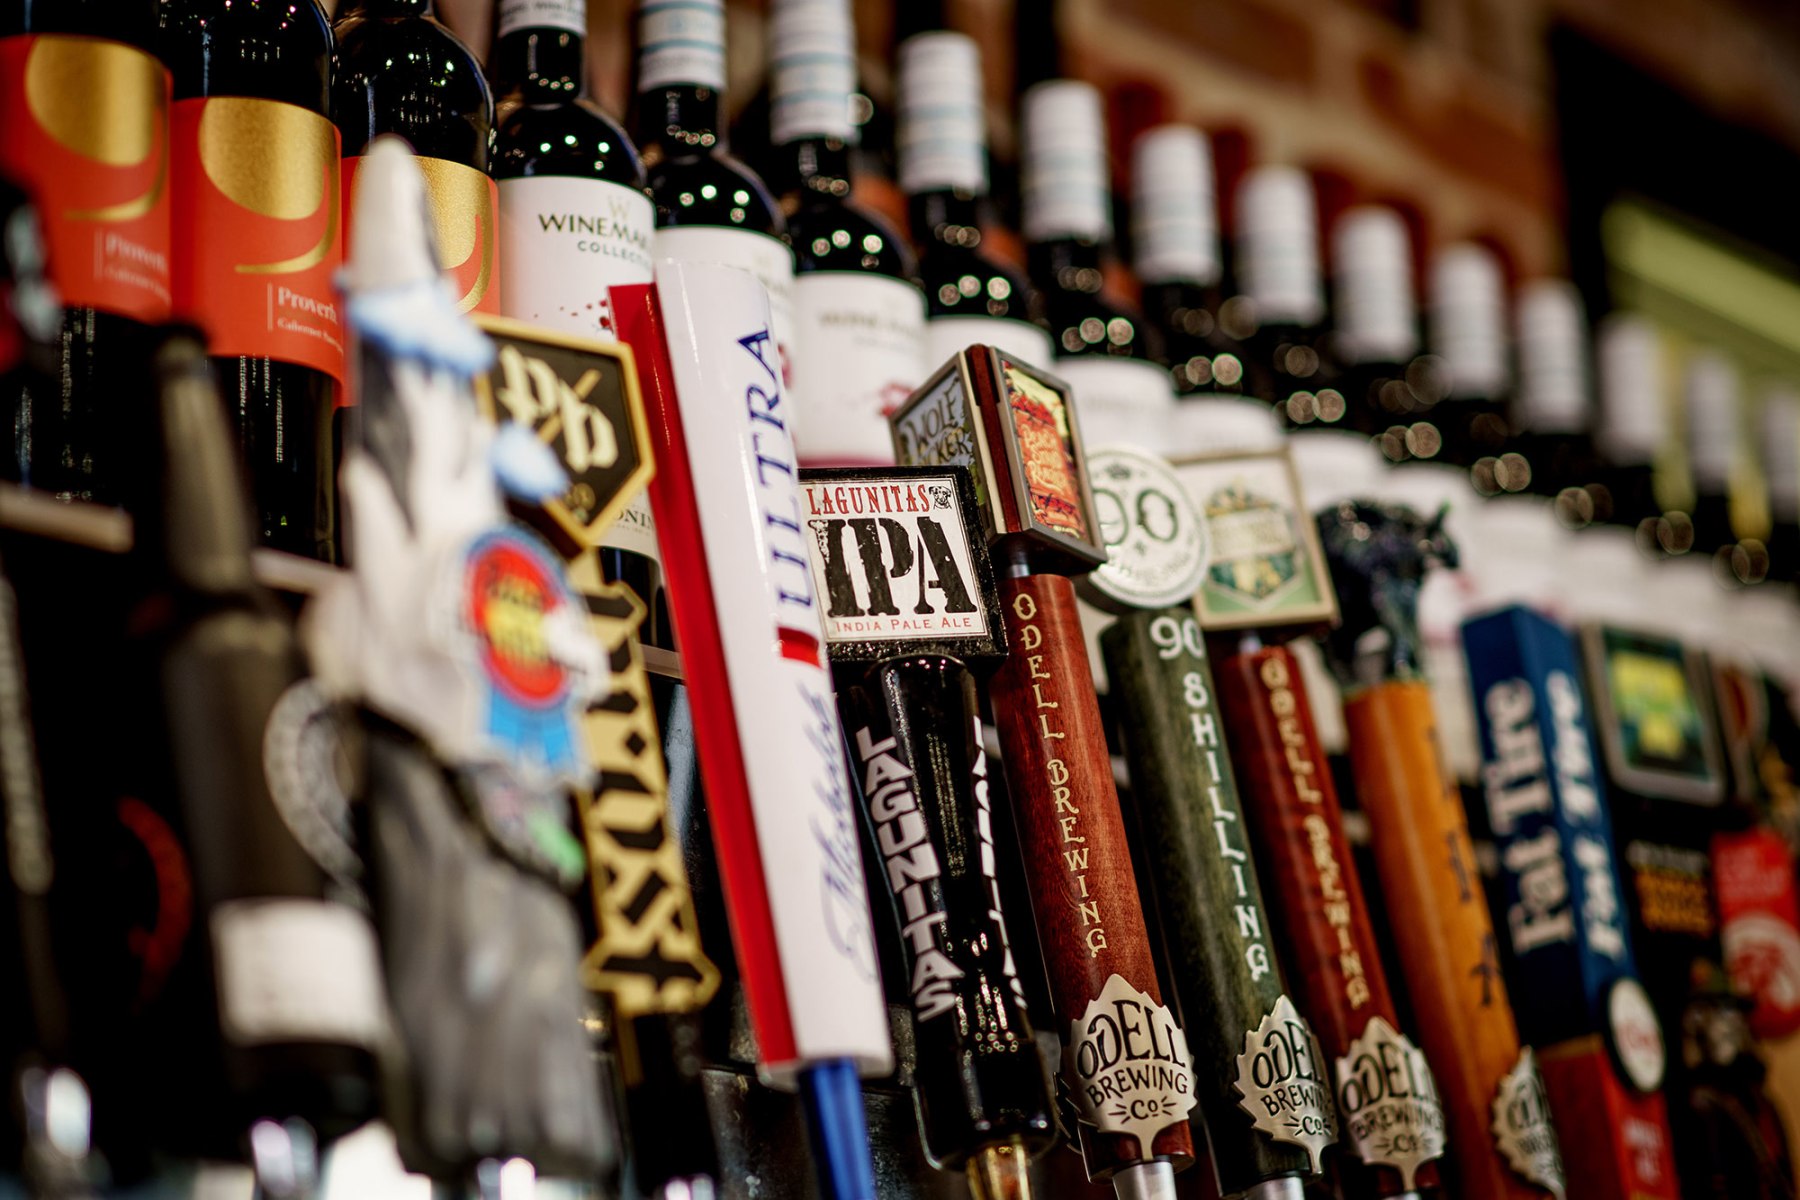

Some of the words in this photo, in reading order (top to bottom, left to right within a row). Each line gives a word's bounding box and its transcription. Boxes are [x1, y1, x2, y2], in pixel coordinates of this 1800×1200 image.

[905, 376, 960, 458] WOLF
[738, 322, 812, 607] ULTRA
[806, 484, 931, 515] LAGUNITAS
[807, 516, 978, 619] IPA
[836, 621, 882, 633] INDIA
[890, 617, 933, 631] PALE
[941, 616, 972, 628] ALE
[1012, 592, 1065, 739] ODELL
[1046, 758, 1108, 959] BREWING
[1150, 615, 1205, 660] 90
[1182, 671, 1270, 982] SHILLING
[856, 725, 966, 1022] LAGUNITAS
[1077, 999, 1187, 1080] ODELL
[1252, 1020, 1325, 1089] ODEL
[1086, 1065, 1188, 1108] BREWING
[1260, 1084, 1332, 1117] BREWIN
